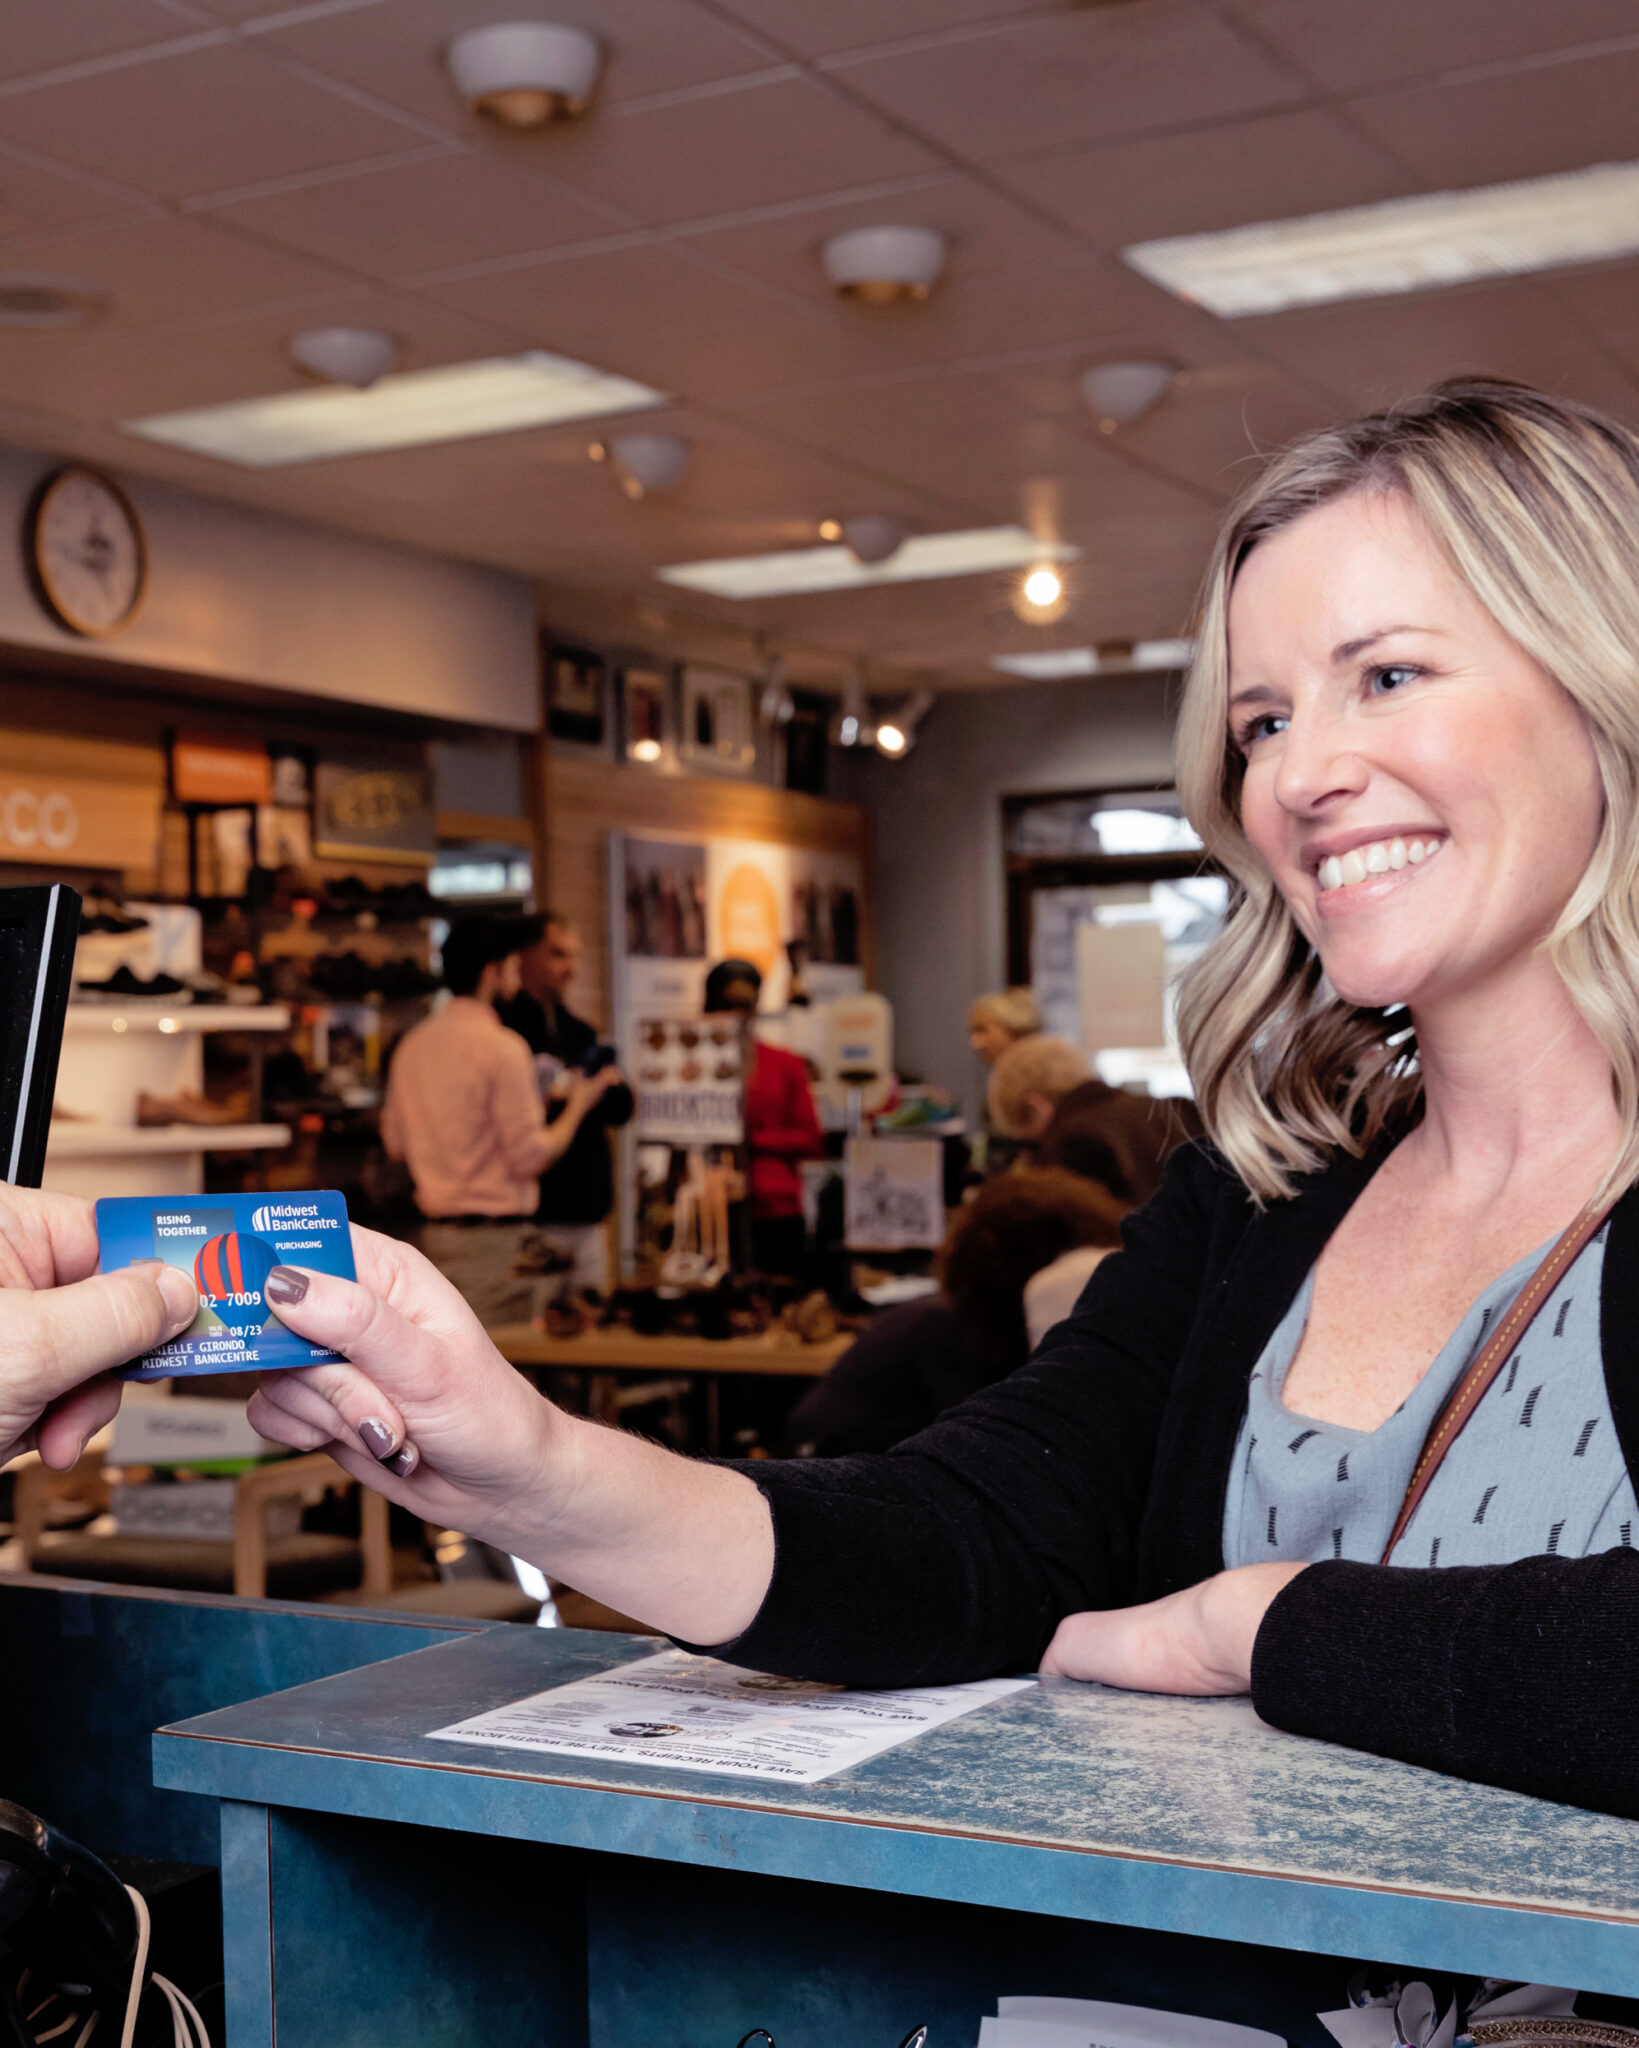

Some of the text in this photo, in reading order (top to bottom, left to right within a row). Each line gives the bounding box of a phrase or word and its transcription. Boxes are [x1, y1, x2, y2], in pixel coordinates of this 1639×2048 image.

[0, 788, 78, 851] CO
[270, 1205, 318, 1217] Midwest
[157, 1215, 191, 1225] RISING
[158, 1226, 207, 1237] TOGETHER
[275, 1241, 322, 1250] PURCHASING
[227, 1291, 261, 1307] 7009
[230, 1325, 262, 1337] 08/23
[199, 1340, 245, 1353] GIRONDO
[142, 1350, 260, 1370] MIDWEST BANKCENTRE
[509, 1735, 560, 1747] WORTH
[565, 1740, 626, 1754] THEY'RE
[716, 1759, 760, 1771] YOUR
[762, 1765, 807, 1775] SAVE
